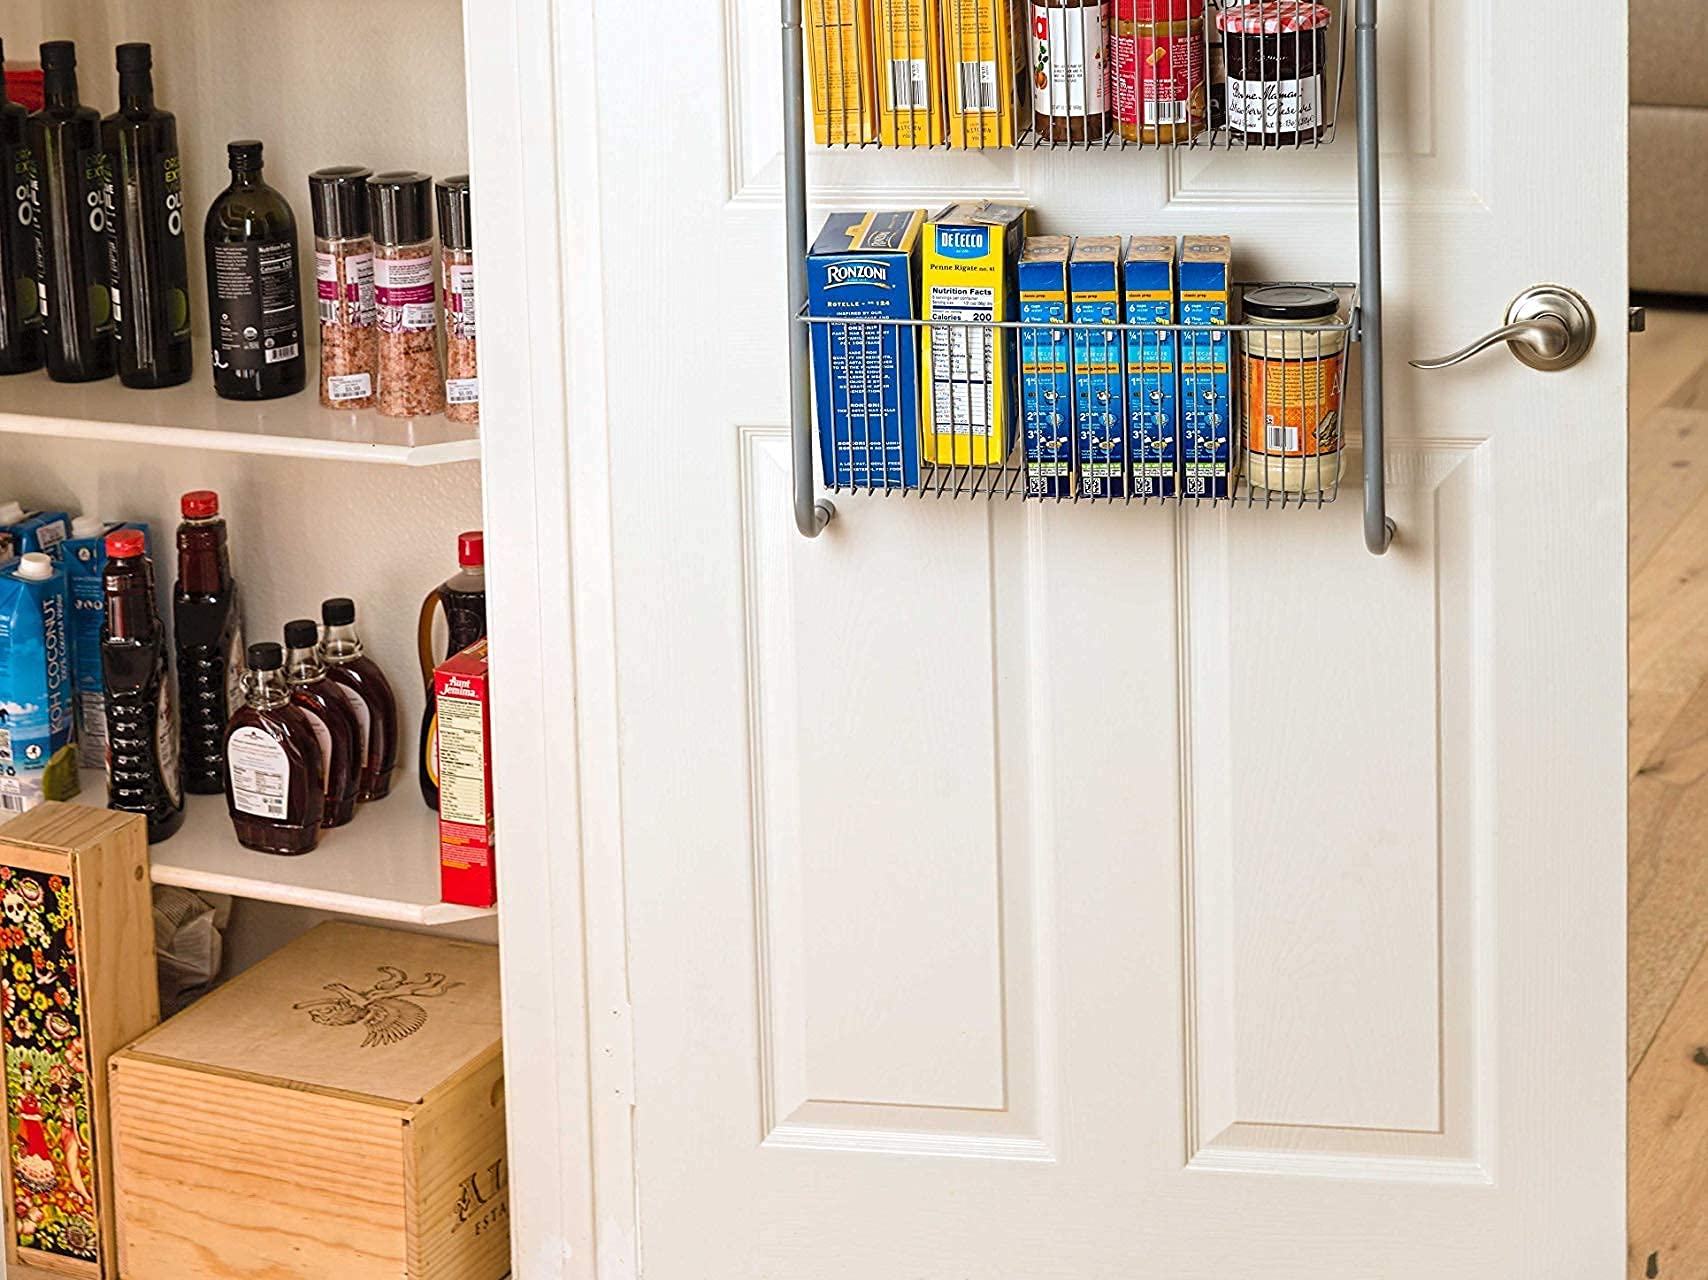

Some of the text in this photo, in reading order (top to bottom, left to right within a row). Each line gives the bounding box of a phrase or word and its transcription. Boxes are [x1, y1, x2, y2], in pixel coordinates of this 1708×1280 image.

[930, 263, 953, 271] Penne
[954, 263, 977, 272] Rigate
[827, 265, 887, 283] RONZONI
[932, 287, 992, 296] Nutrition Facts
[932, 313, 992, 322] Calories 200
[43, 598, 64, 735] KOH COCONUT
[449, 676, 471, 688] Aunt
[440, 683, 476, 697] Jemima
